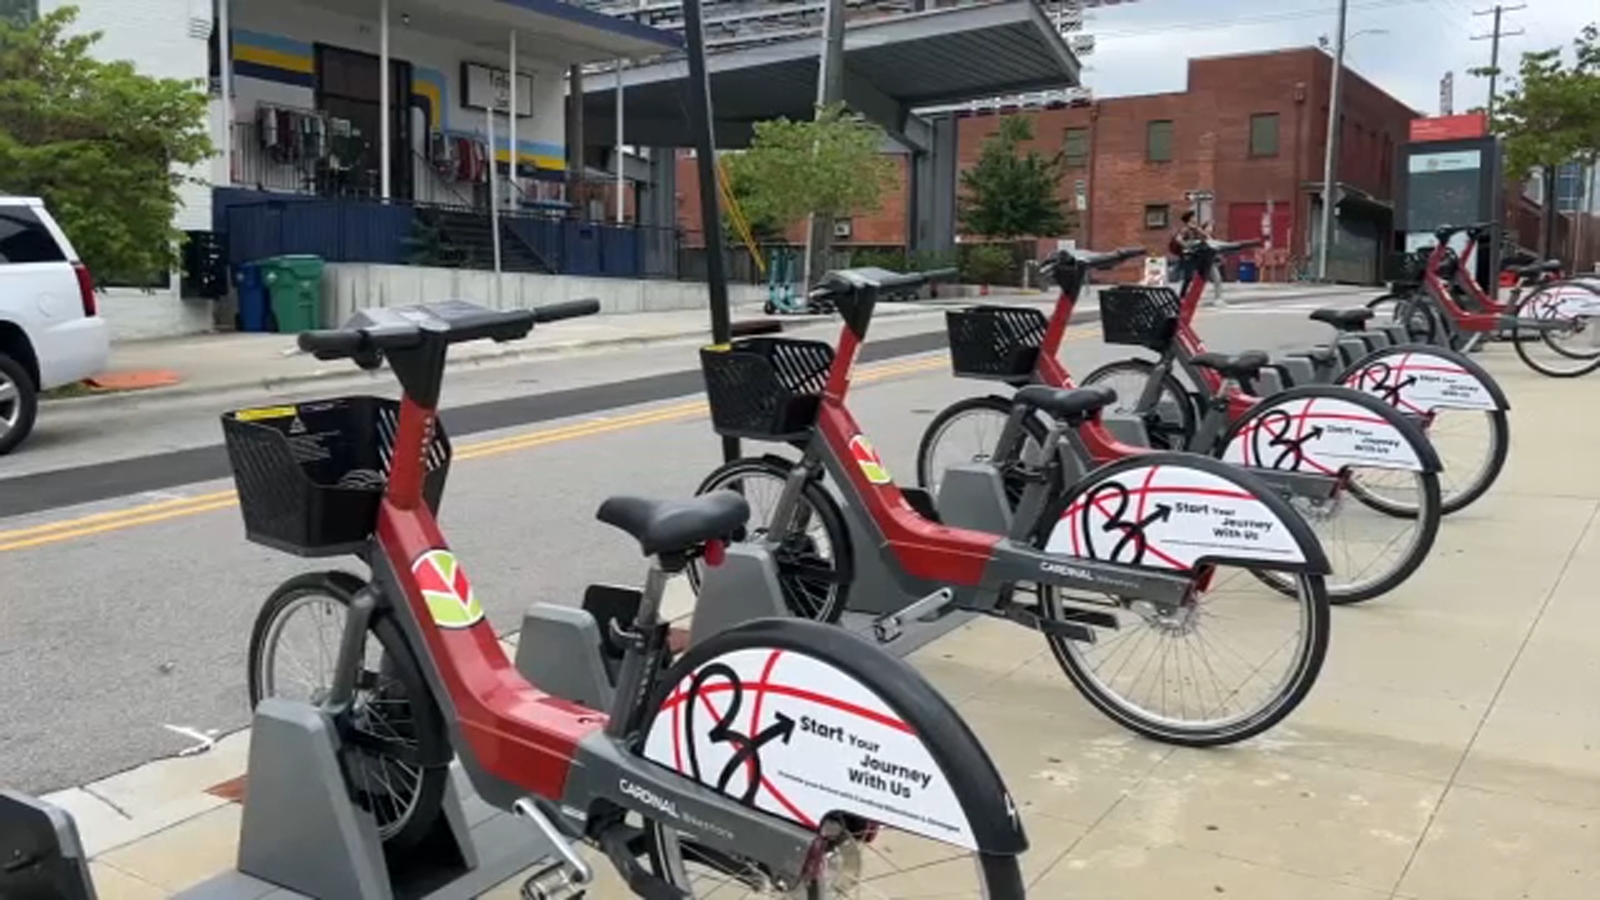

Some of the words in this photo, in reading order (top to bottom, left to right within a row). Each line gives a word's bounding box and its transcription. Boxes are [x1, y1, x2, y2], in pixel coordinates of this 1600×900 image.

[1175, 502, 1209, 515] Start
[1212, 527, 1242, 539] With
[1221, 518, 1273, 532] Journey
[800, 716, 844, 743] Start
[849, 734, 880, 753] Your
[848, 767, 887, 792] With
[890, 781, 911, 799] Us
[860, 754, 932, 789] Journey
[619, 778, 681, 819] CARDINAL
